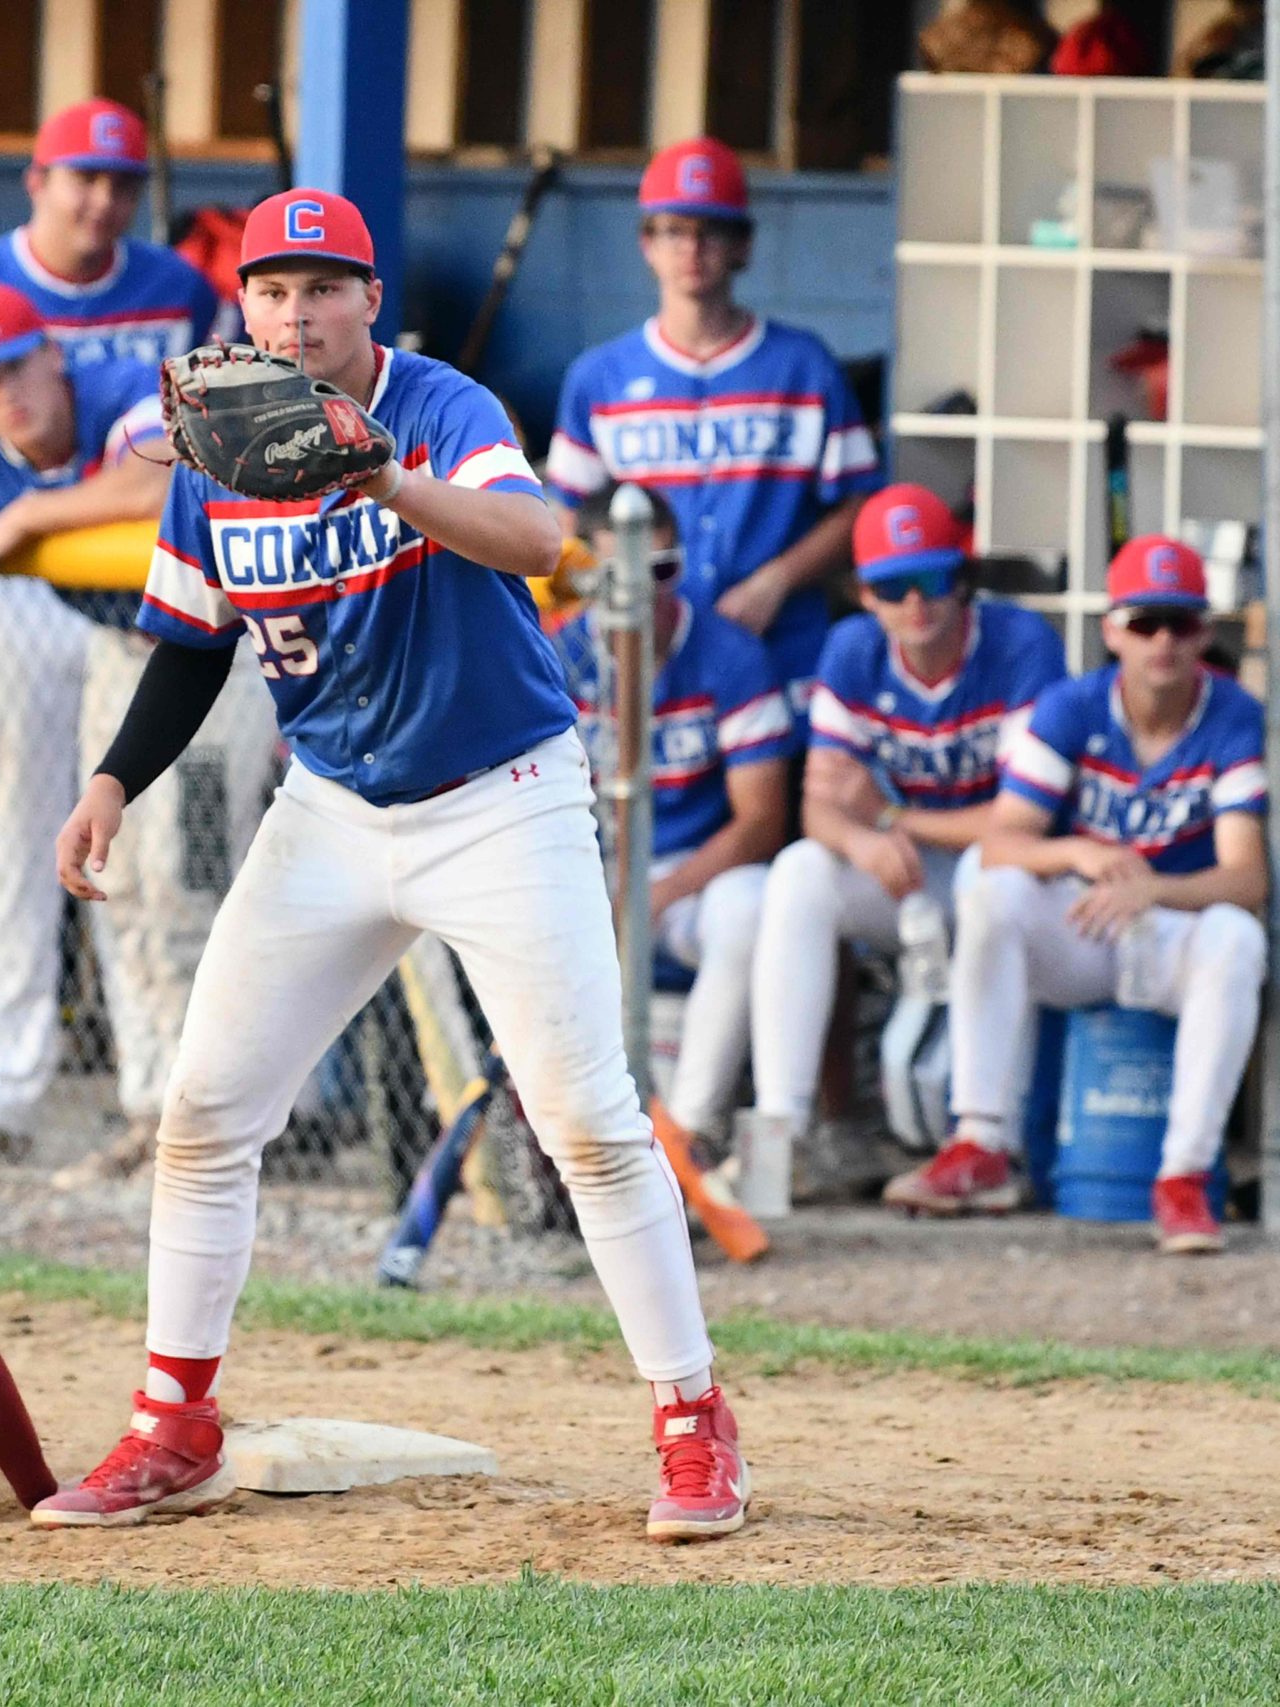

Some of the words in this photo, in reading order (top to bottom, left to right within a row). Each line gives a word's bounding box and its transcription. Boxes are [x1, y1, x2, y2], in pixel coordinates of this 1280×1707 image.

[89, 111, 125, 151] C
[676, 155, 713, 196] C
[285, 200, 325, 242] C
[886, 504, 923, 547] C
[1145, 544, 1180, 584] C
